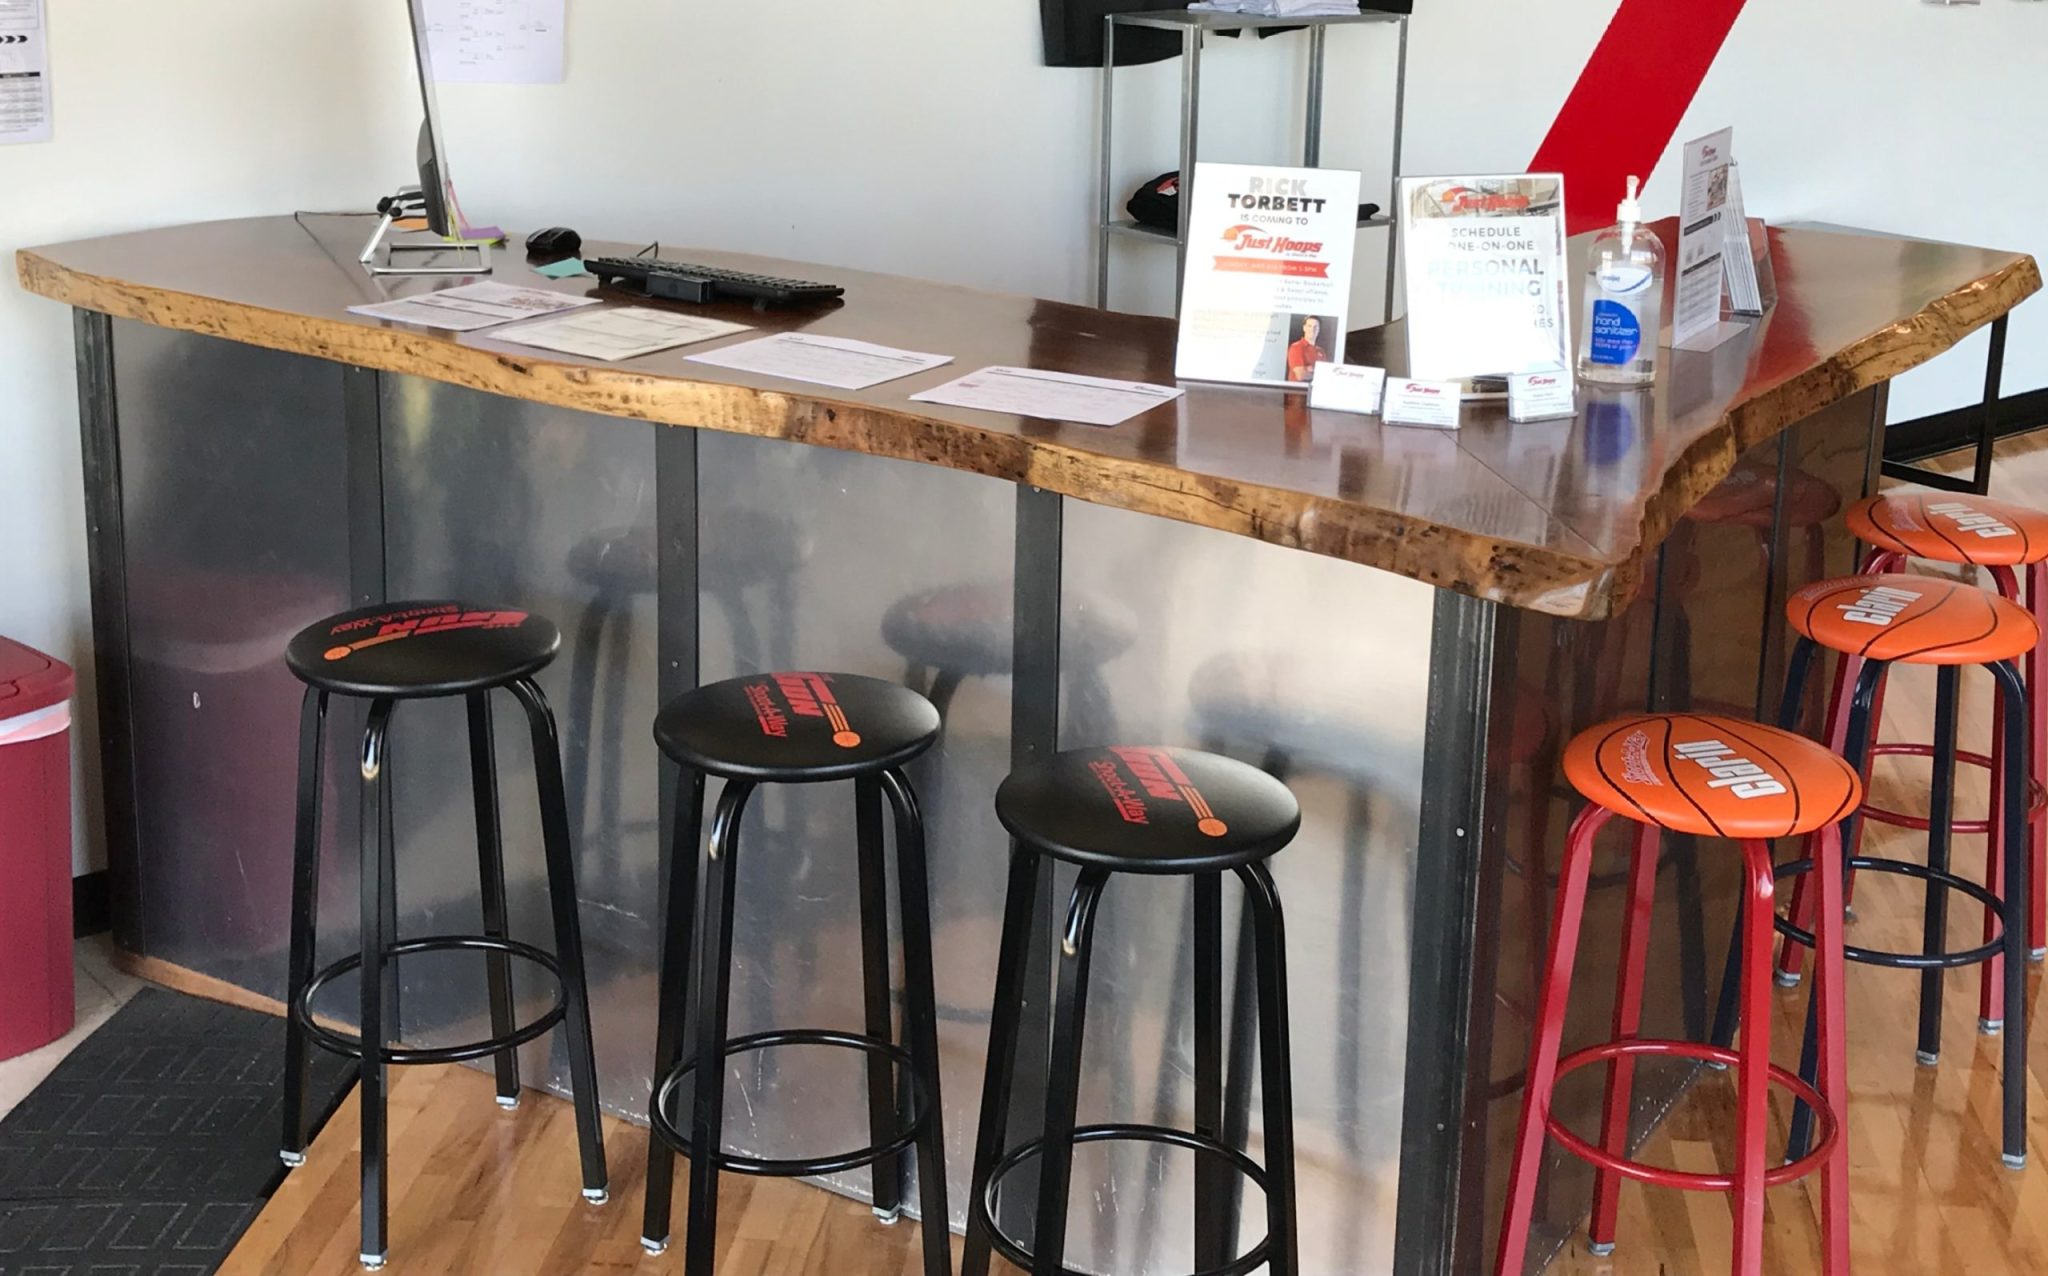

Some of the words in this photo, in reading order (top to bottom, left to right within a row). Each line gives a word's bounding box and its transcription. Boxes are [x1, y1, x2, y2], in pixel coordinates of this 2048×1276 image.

[1249, 176, 1308, 196] RICK
[1228, 193, 1326, 213] TORBETT
[1240, 214, 1249, 222] IS
[1252, 214, 1293, 225] COMING
[1295, 216, 1308, 226] TO
[1451, 226, 1521, 238] SCHEDULE
[1234, 234, 1274, 251] Just
[1271, 236, 1323, 253] Hoops
[1448, 240, 1534, 251] ONE-ON-ONE
[1427, 258, 1545, 276] PERSONAL
[1438, 279, 1541, 297] TRINING
[1595, 316, 1621, 326] hand
[1594, 326, 1637, 336] sanitizer
[1836, 586, 1923, 626] clarin
[1673, 739, 1787, 800] clarin
